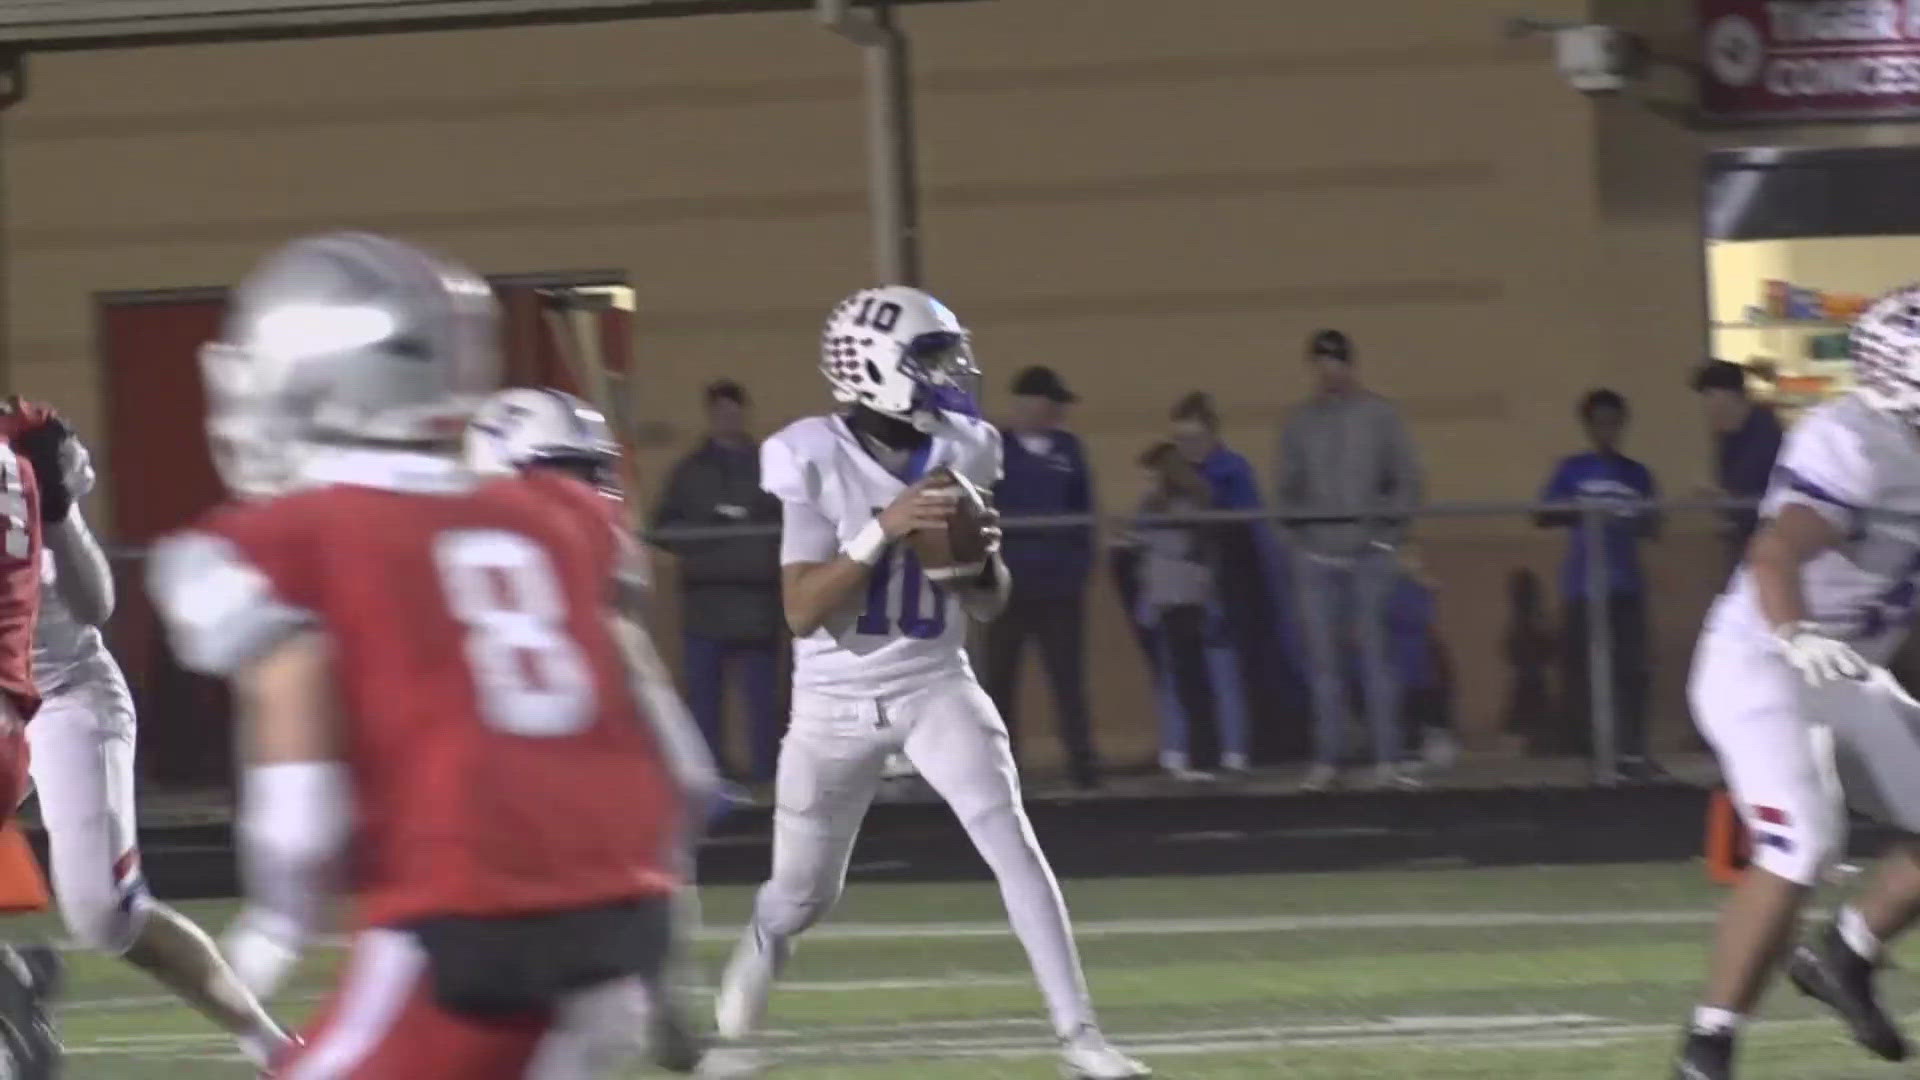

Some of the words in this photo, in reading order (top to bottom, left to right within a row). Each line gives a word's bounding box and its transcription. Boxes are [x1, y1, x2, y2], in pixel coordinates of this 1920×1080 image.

[1766, 0, 1900, 40] TIGER
[854, 297, 902, 333] 10
[855, 544, 947, 640] 10
[433, 528, 599, 736] 8
